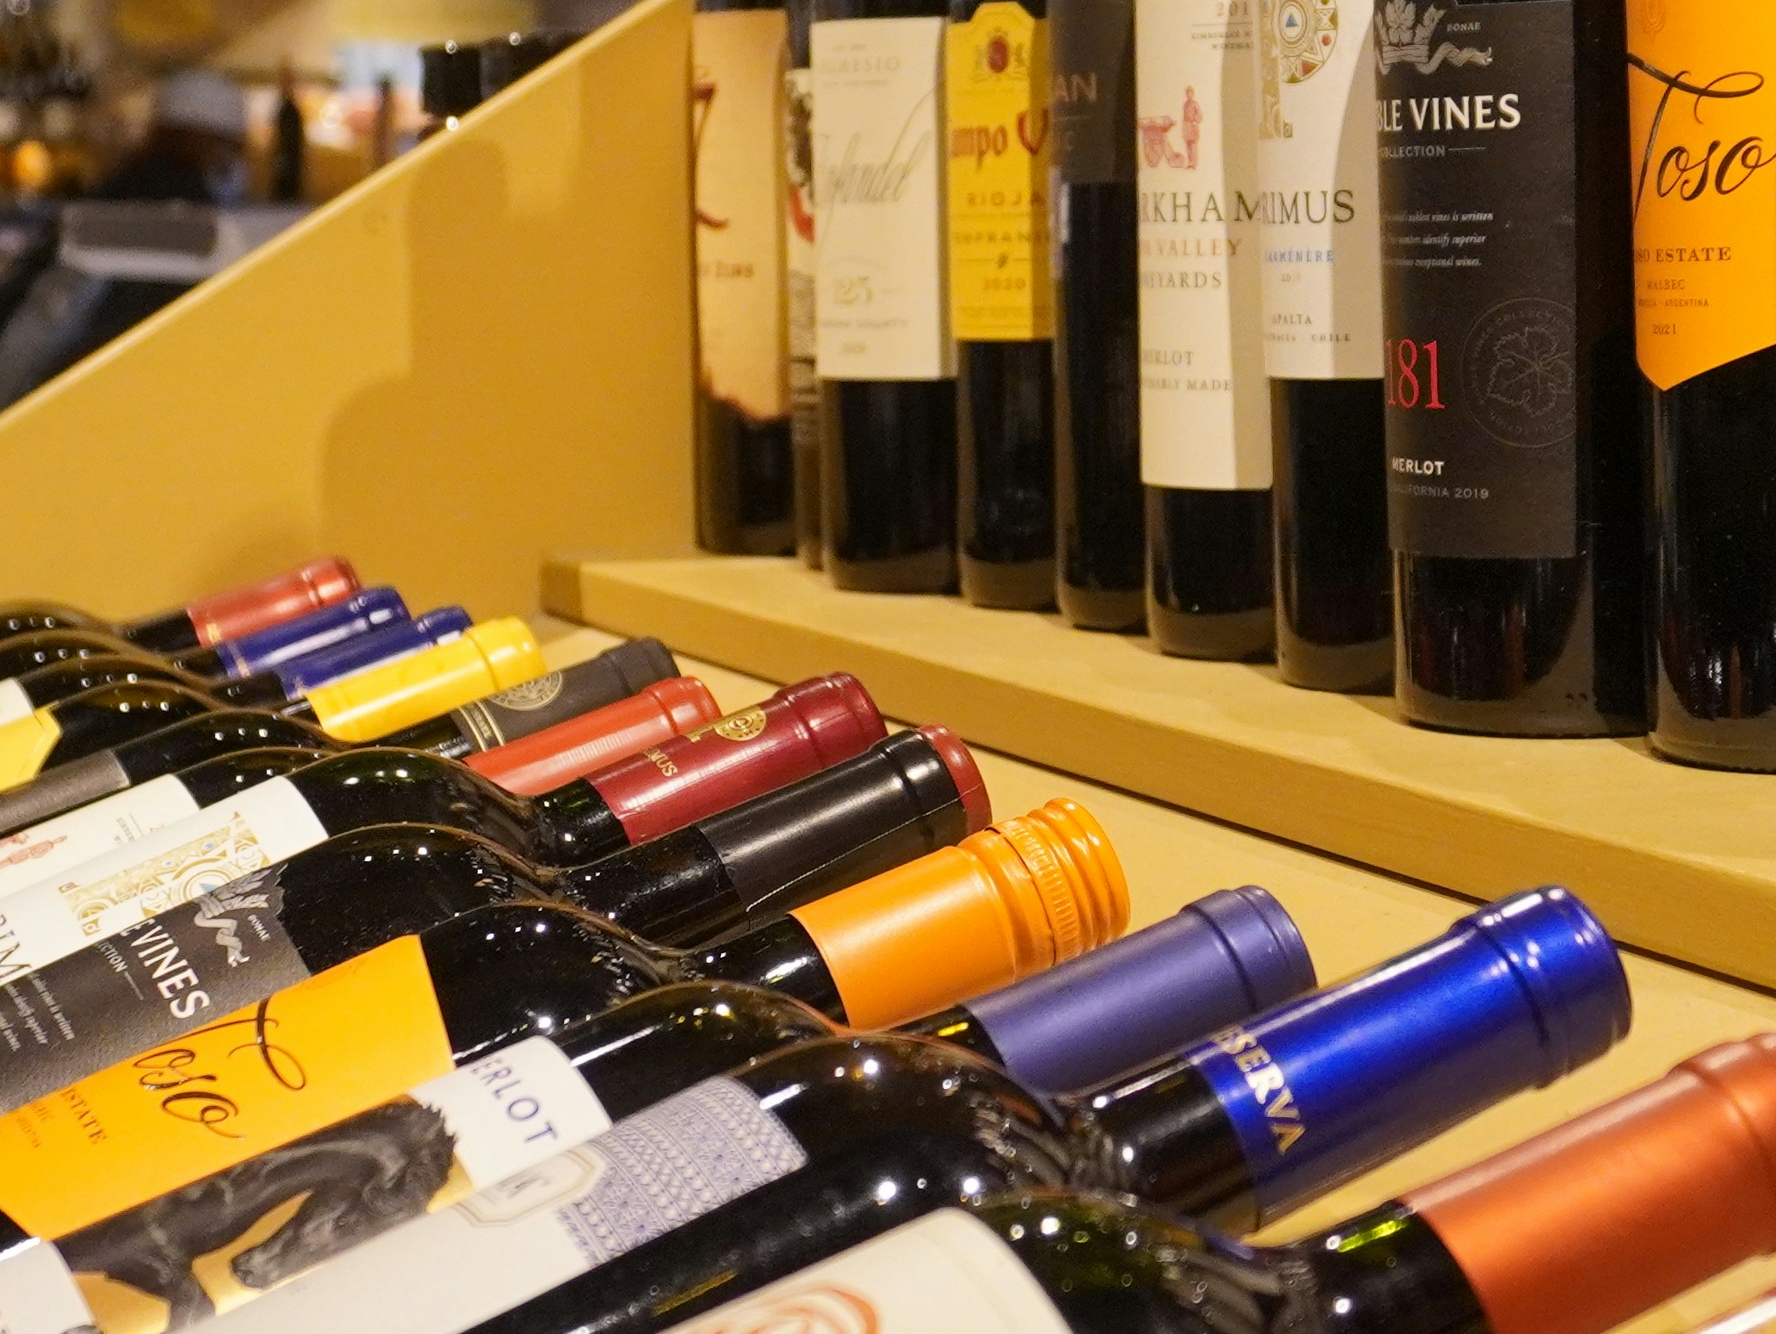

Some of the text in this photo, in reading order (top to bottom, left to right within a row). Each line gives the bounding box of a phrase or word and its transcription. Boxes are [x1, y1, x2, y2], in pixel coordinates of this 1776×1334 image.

[1376, 93, 1521, 131] BLE VINES
[1140, 190, 1260, 223] RKHAM
[1260, 190, 1355, 224] RIMUS
[1656, 247, 1731, 263] ESTATE
[1385, 338, 1445, 410] 181
[1392, 456, 1444, 476] MERLOT
[1454, 488, 1489, 499] 2019
[129, 918, 211, 1020] VINES
[469, 1056, 559, 1145] ERLOT
[1209, 1023, 1307, 1155] ESERVA
